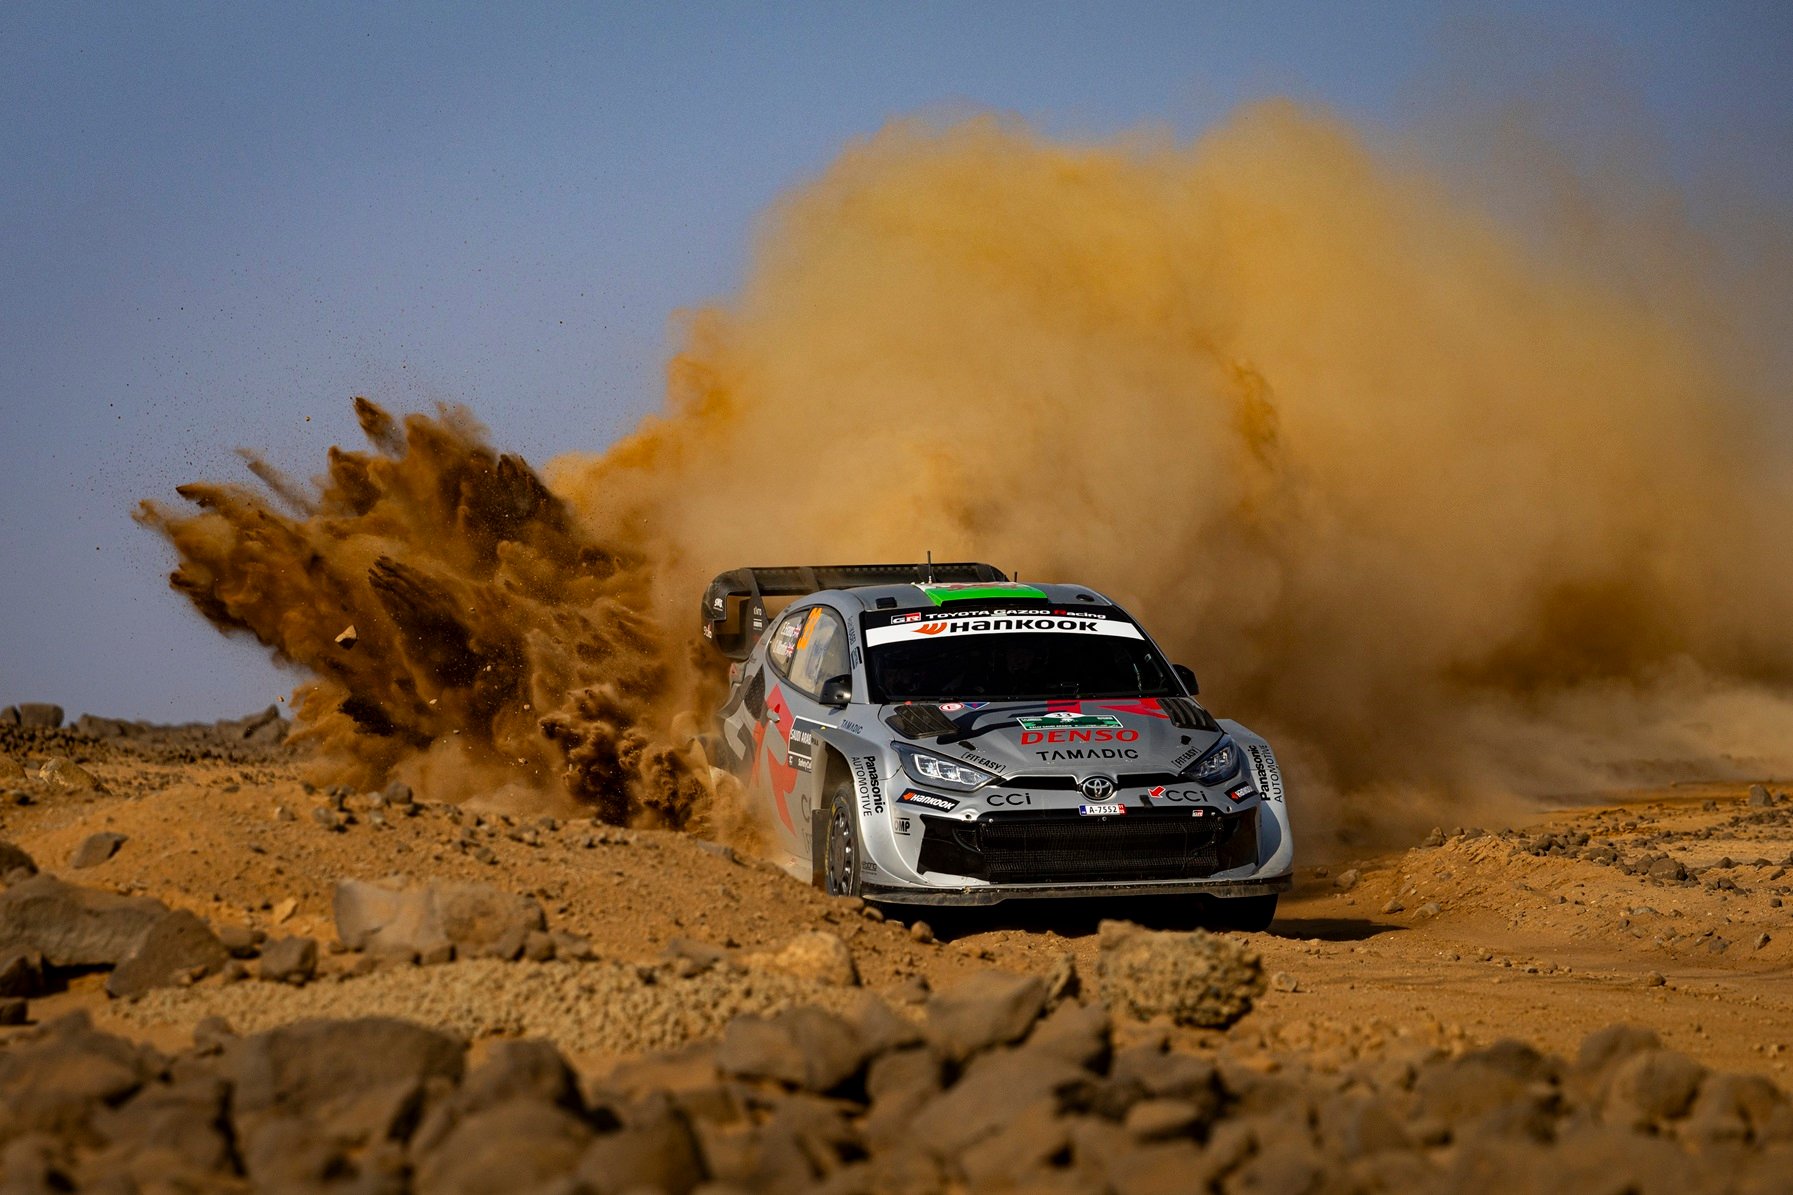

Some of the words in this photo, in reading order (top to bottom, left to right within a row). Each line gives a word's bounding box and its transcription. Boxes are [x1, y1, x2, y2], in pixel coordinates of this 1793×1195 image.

[891, 615, 920, 624] GR
[925, 610, 990, 619] TOYOTA
[1053, 609, 1107, 620] Racing
[1021, 729, 1139, 745] DENSO
[1036, 749, 1139, 761] TAMADIC
[1248, 744, 1271, 801] Panasonic
[1259, 744, 1283, 803] AUTOMOTIVE
[851, 756, 873, 817] AUTOMOTIVE
[864, 755, 886, 814] Panasonic
[1089, 806, 1118, 814] A-7552
[894, 820, 911, 833] OMP
